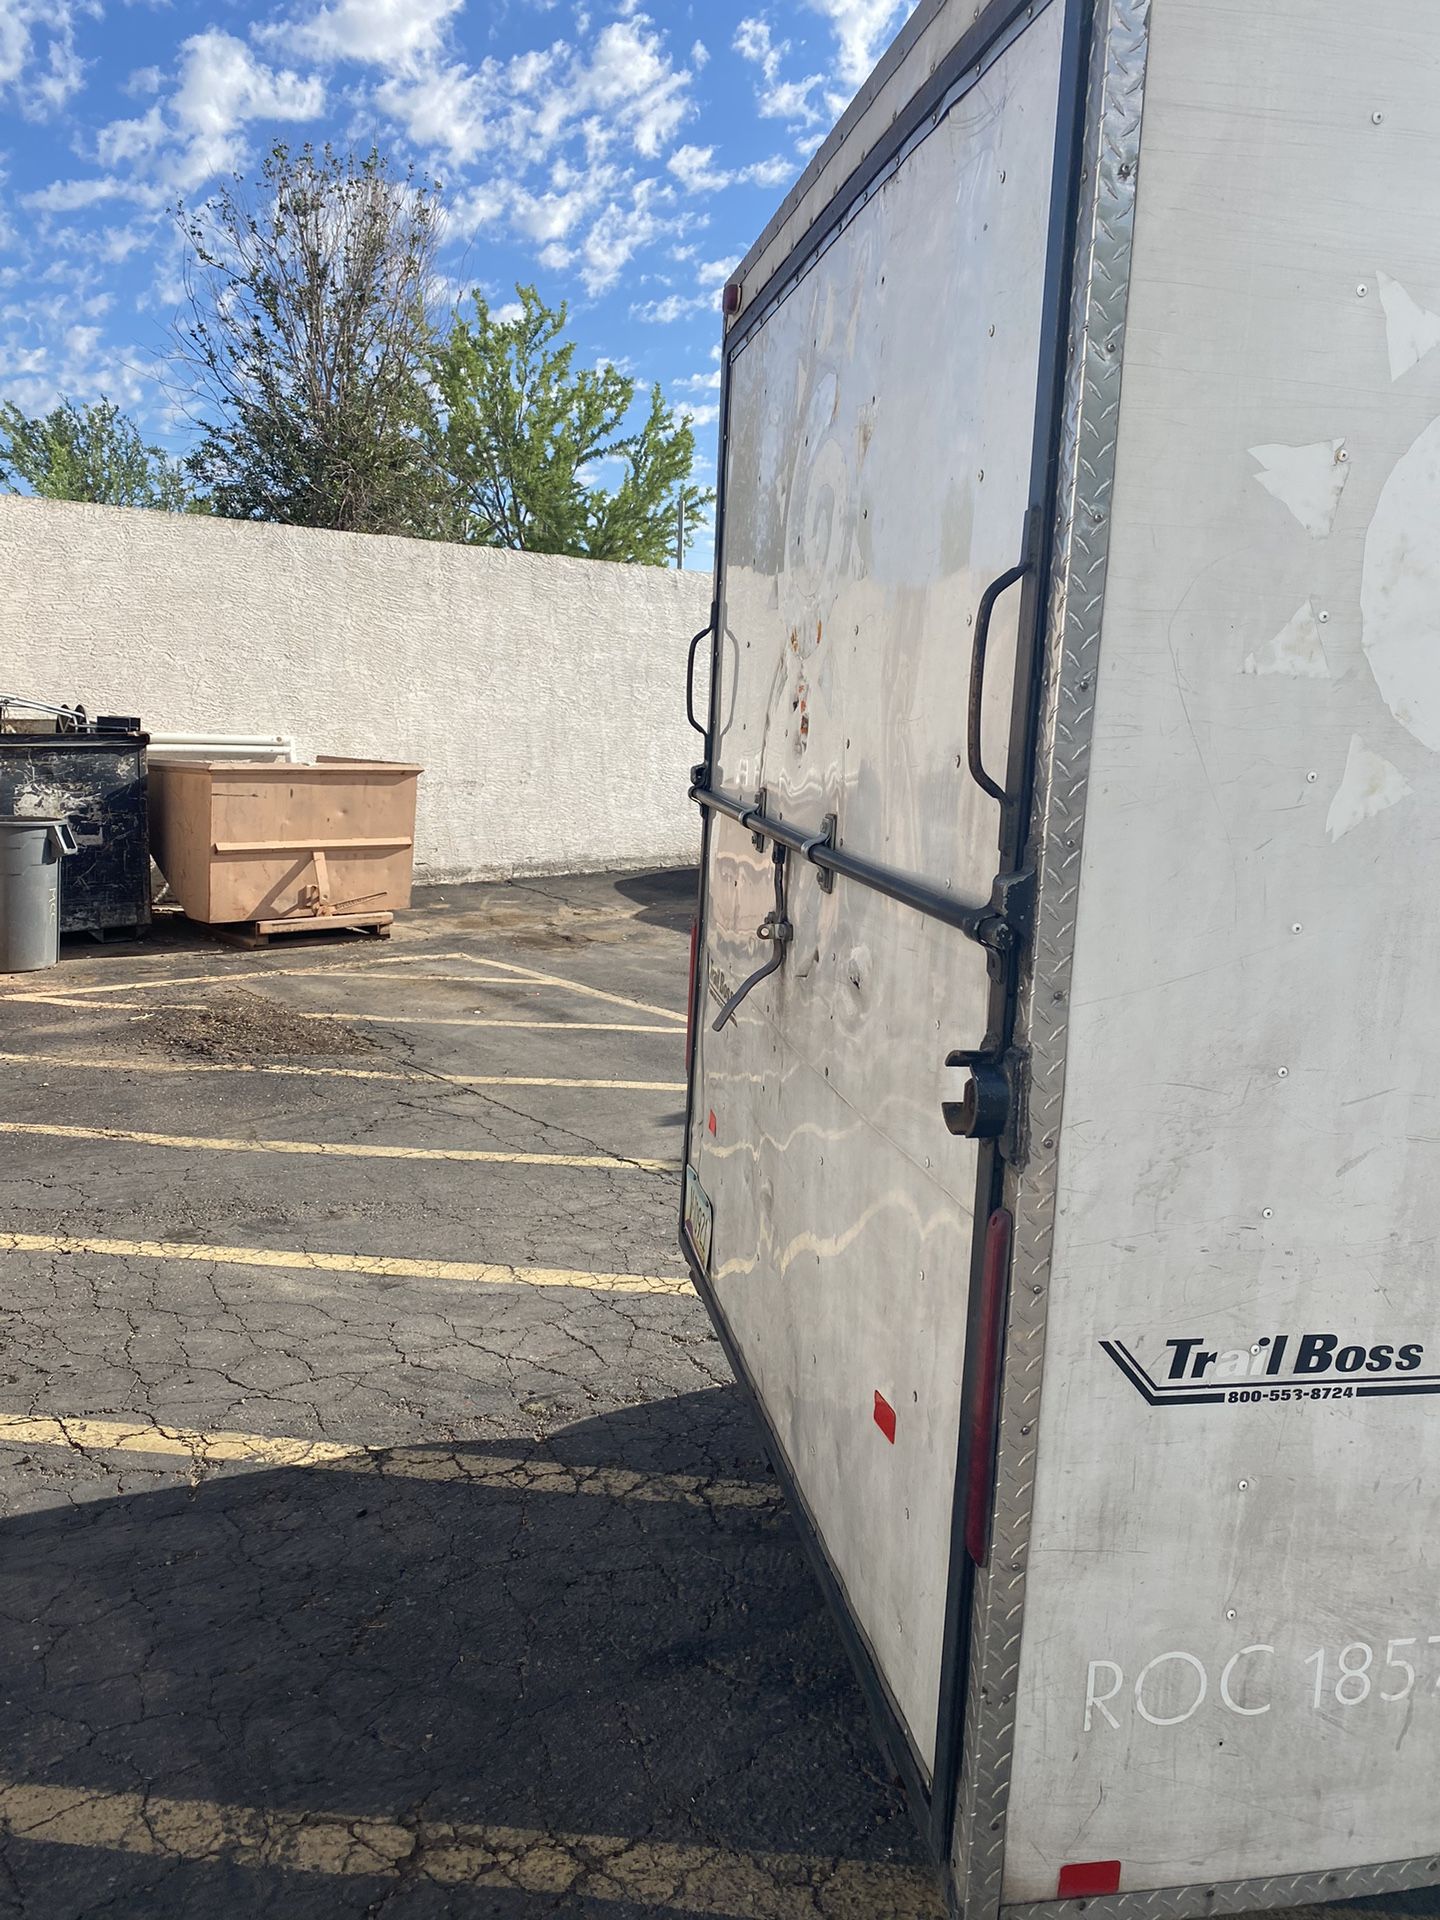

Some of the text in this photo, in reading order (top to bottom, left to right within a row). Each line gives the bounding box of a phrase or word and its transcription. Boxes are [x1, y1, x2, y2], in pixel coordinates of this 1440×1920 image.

[1165, 1334, 1424, 1380] Trail Boss
[1227, 1386, 1354, 1404] 800-553-8724
[1083, 1644, 1275, 1731] ROC
